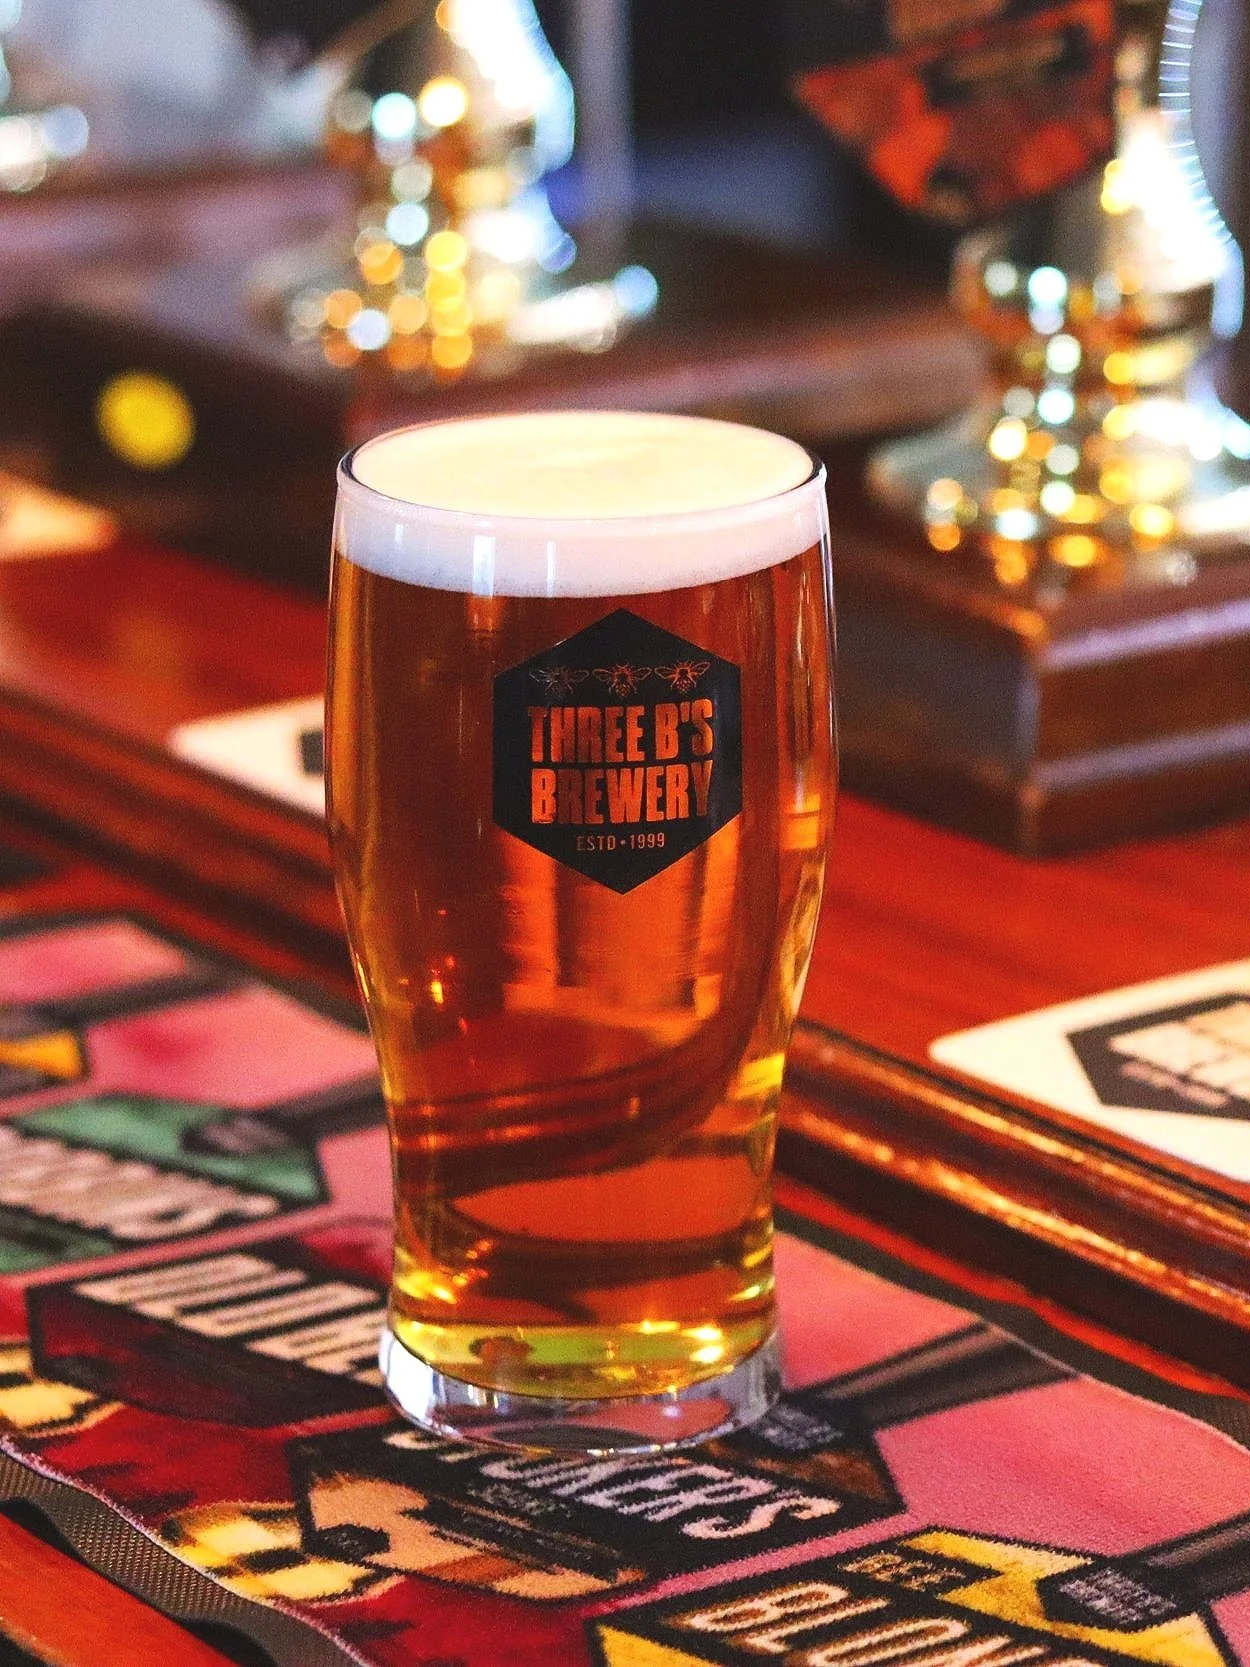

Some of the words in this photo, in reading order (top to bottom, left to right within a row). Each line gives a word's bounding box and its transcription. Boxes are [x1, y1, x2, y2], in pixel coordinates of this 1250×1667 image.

[528, 704, 646, 763] THREE
[655, 699, 714, 760] B'S
[531, 760, 714, 824] BREWERY
